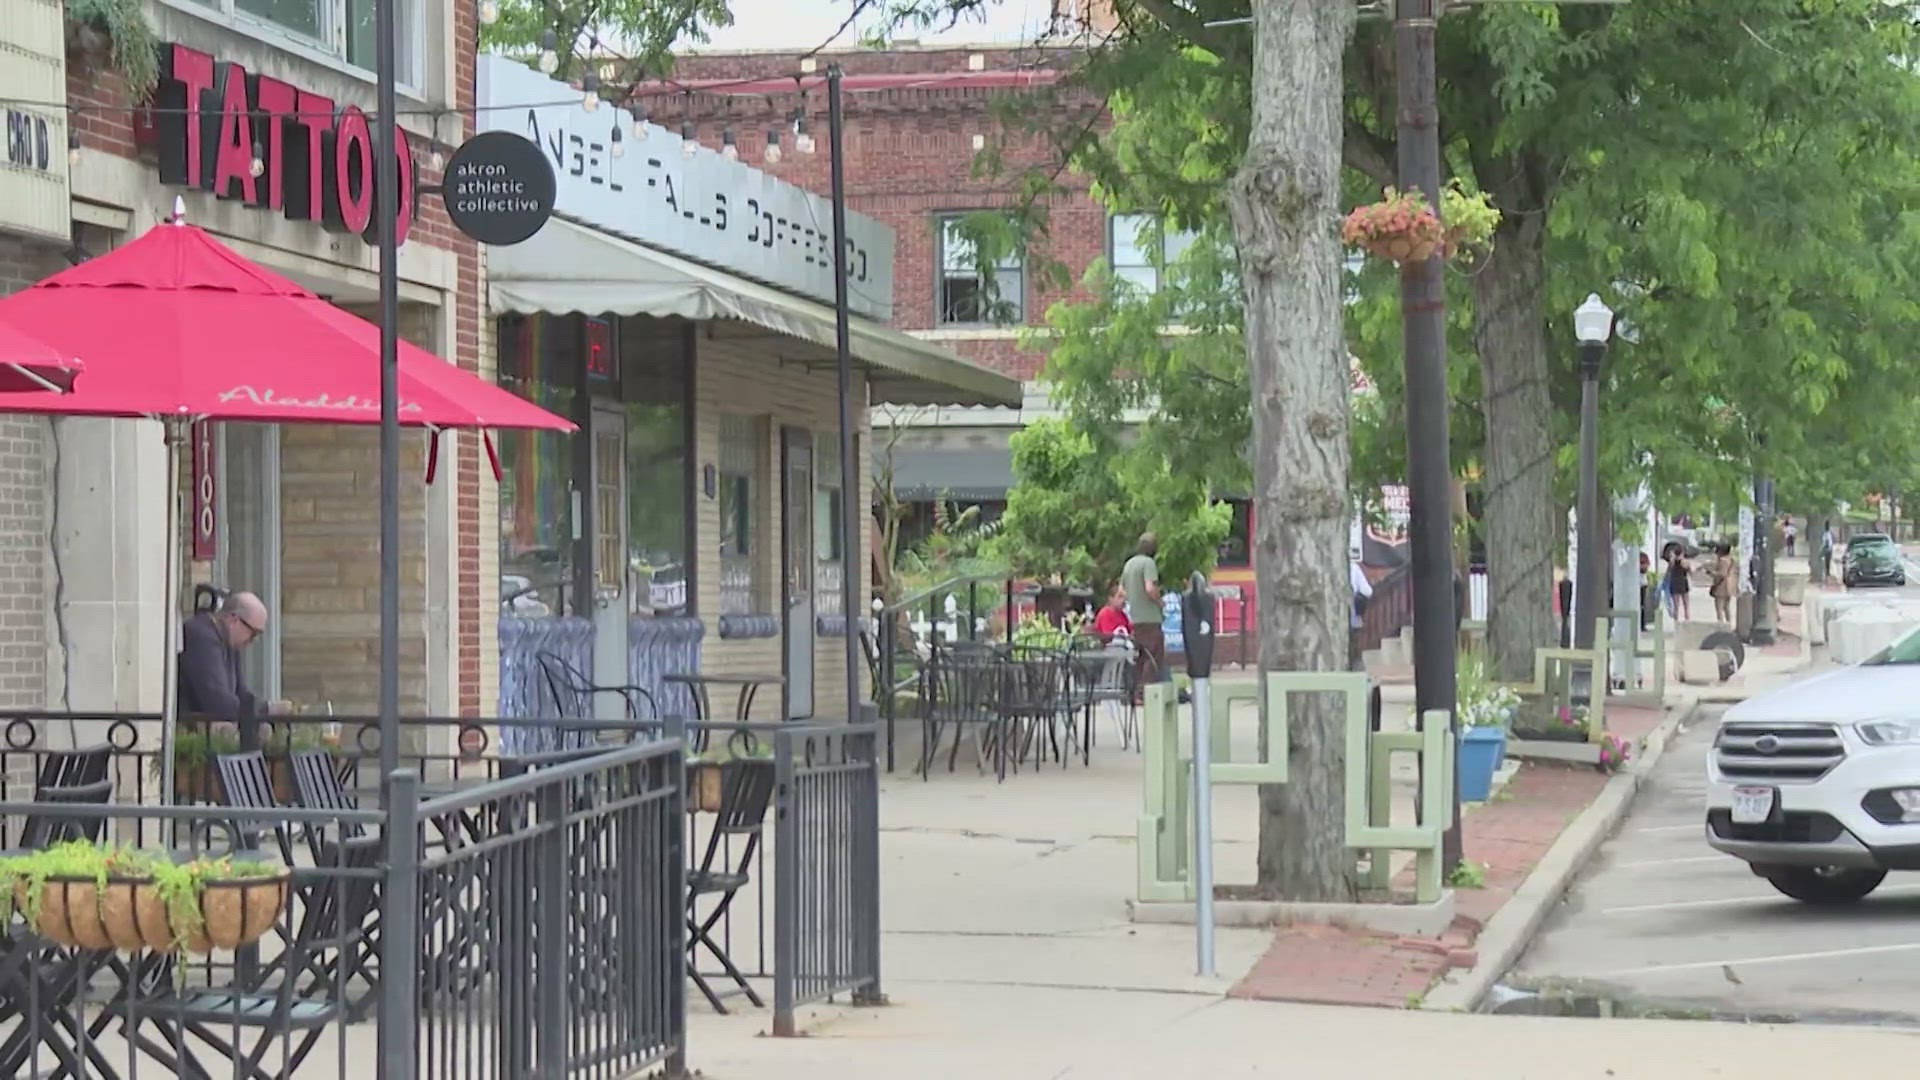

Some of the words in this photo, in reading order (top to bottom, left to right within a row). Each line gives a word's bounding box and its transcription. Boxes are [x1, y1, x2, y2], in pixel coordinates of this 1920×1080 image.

[457, 162, 506, 176] akron
[457, 179, 524, 194] athletic
[457, 197, 540, 212] collective
[647, 158, 727, 231] FALLS
[747, 198, 828, 268] COFFEE
